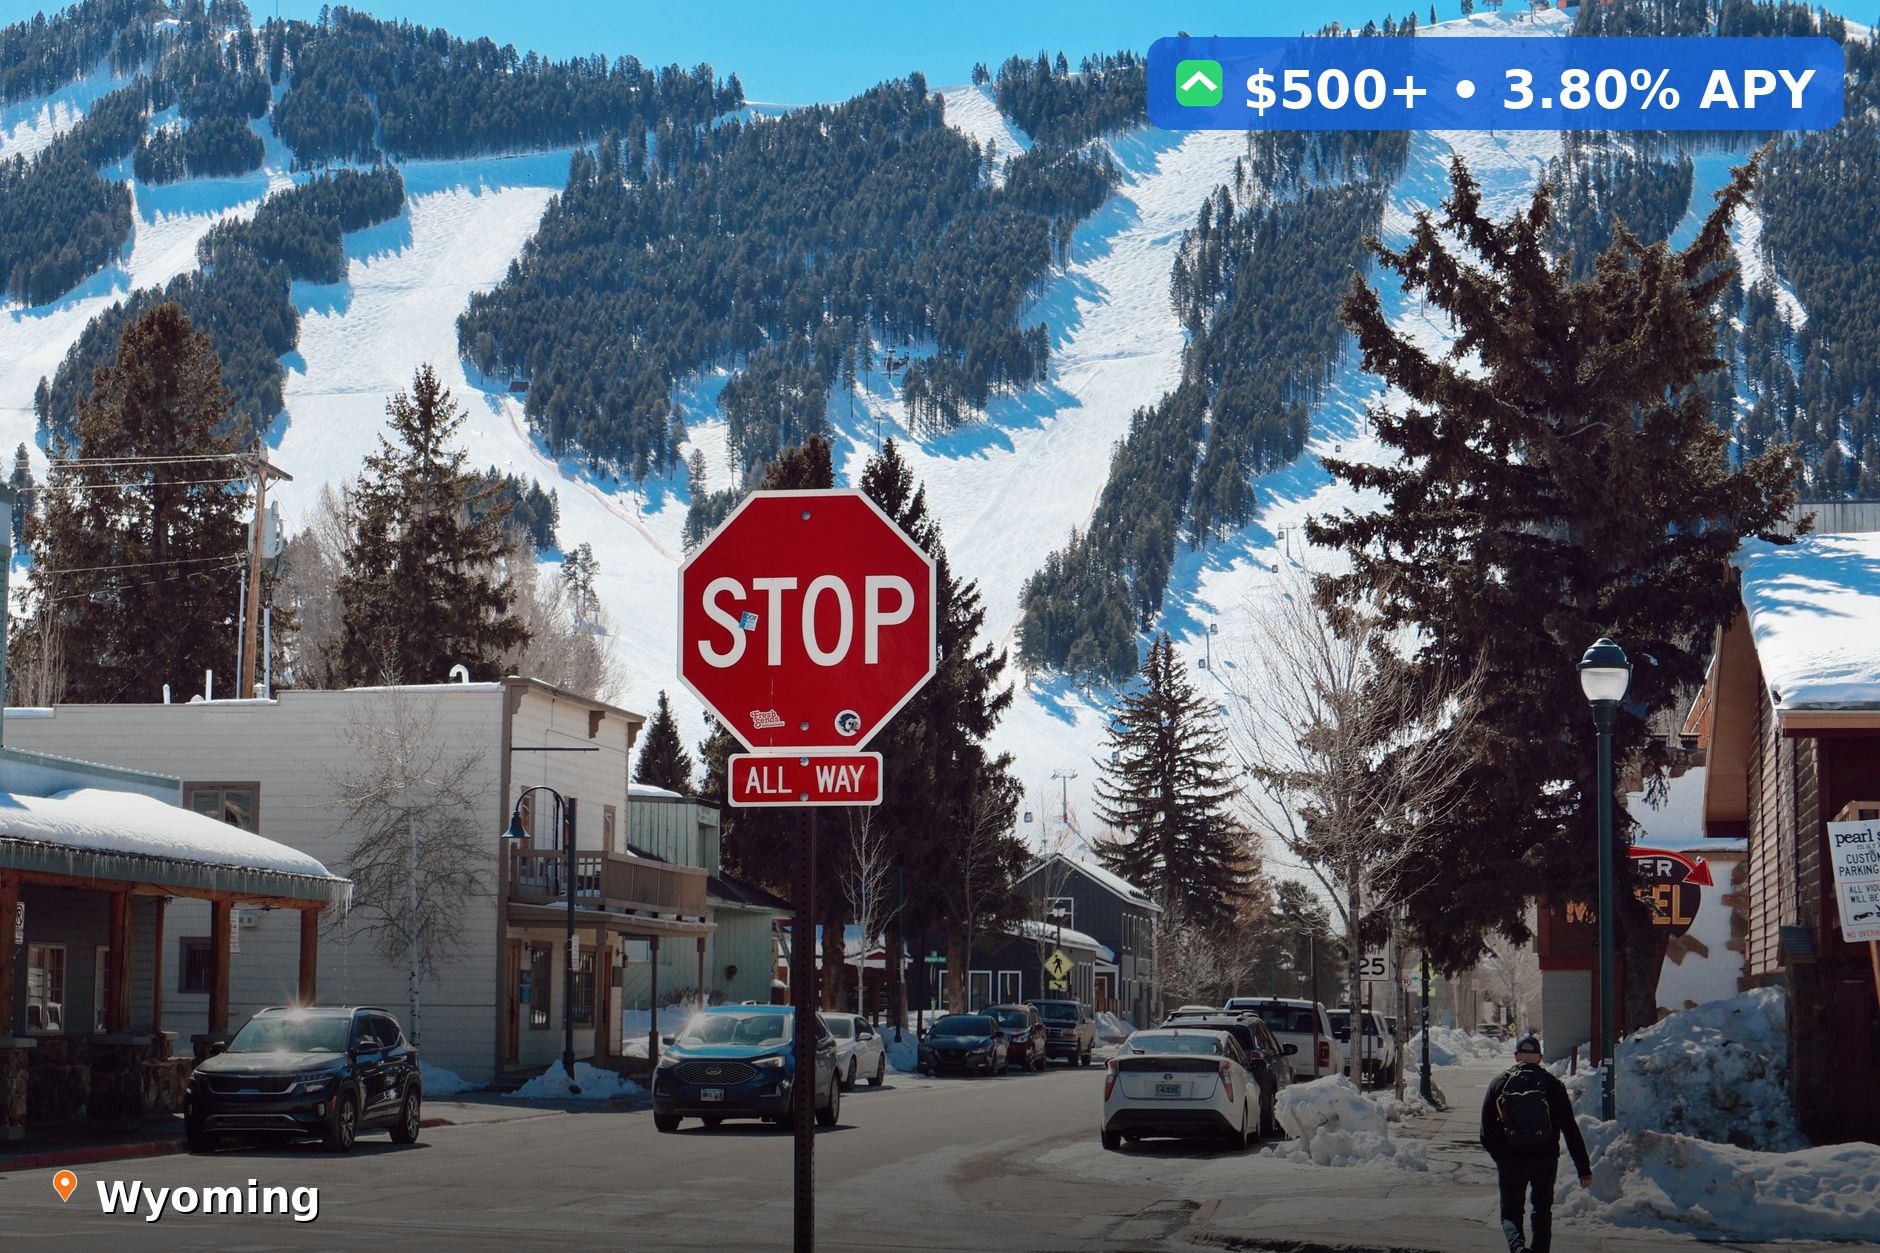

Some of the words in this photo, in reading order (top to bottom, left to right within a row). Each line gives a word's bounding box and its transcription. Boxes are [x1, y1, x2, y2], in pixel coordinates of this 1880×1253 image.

[697, 574, 915, 668] STOP
[745, 765, 792, 794] ALL
[816, 765, 865, 793] WAY
[1835, 828, 1874, 848] pearl
[1839, 864, 1879, 877] PARKING
[1850, 885, 1862, 893] ALL
[1360, 957, 1385, 976] 25
